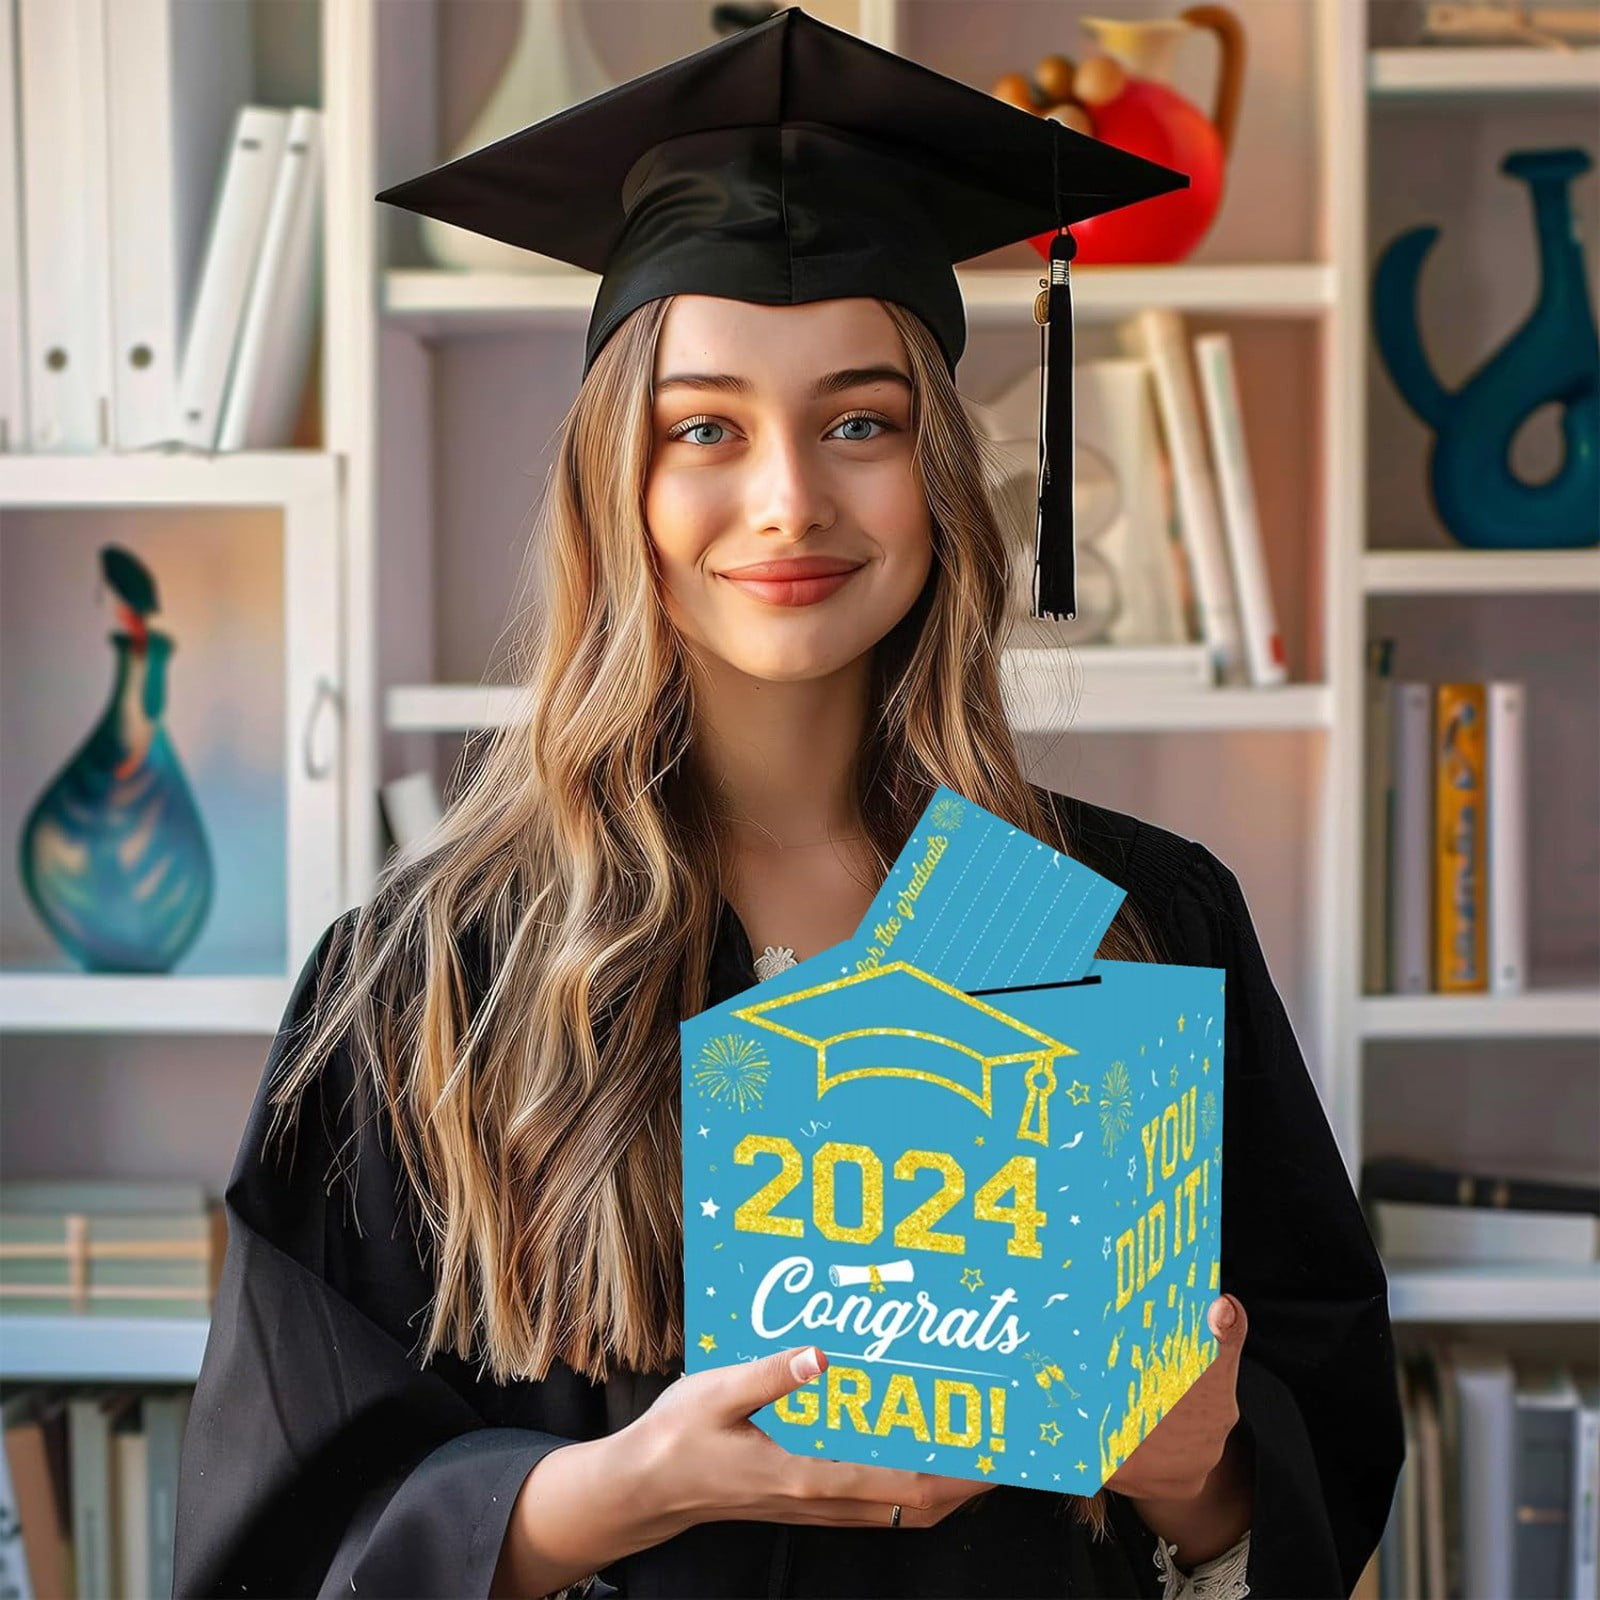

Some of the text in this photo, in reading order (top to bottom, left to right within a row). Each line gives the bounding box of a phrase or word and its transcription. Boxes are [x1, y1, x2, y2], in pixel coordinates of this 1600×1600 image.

[874, 916, 902, 947] the
[897, 834, 948, 920] graduate
[733, 1133, 1047, 1259] 2024
[1141, 1085, 1197, 1197] YOU
[1115, 1158, 1209, 1312] DID IT!
[751, 1256, 1031, 1362] Congrats
[774, 1366, 1006, 1453] GRAD!
